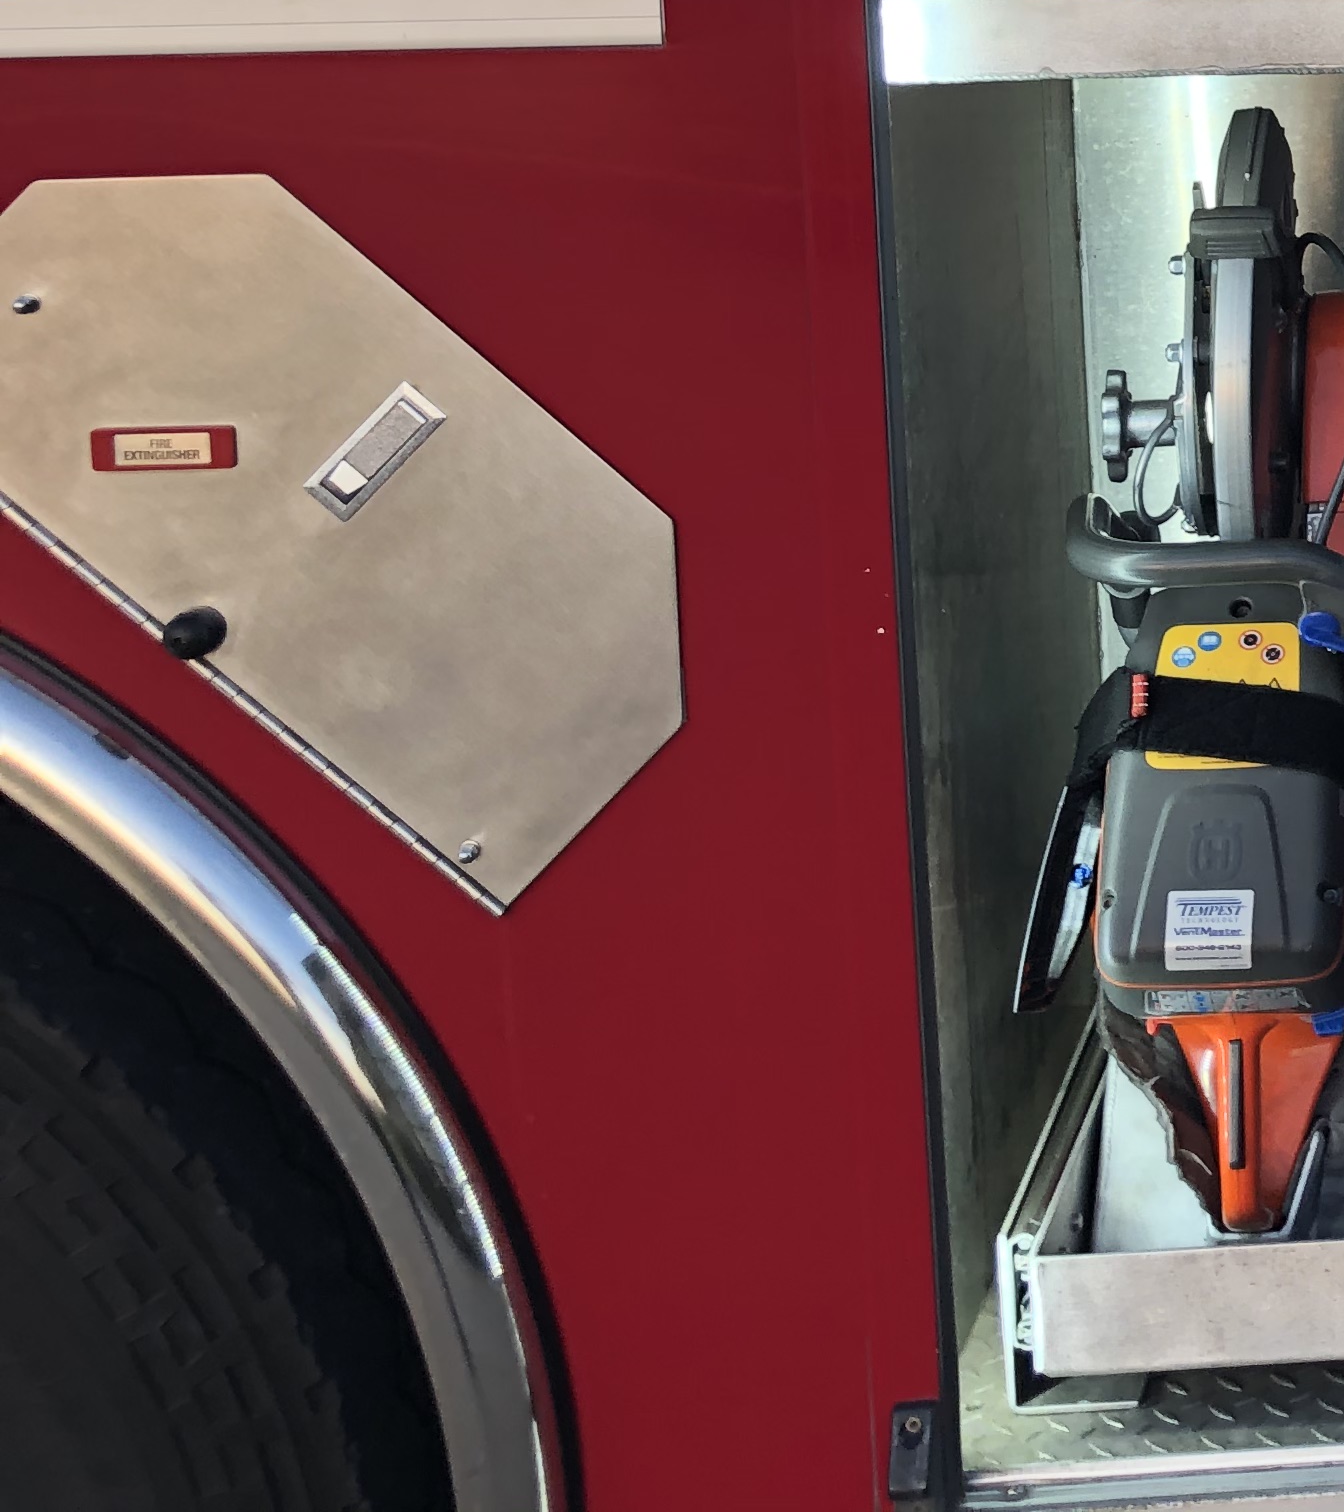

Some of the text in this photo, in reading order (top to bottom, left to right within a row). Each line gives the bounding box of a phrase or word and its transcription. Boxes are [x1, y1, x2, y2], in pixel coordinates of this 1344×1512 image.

[149, 439, 173, 449] FIRE
[123, 449, 201, 461] EXTINGUISHER
[1177, 901, 1244, 917] TEMPEST
